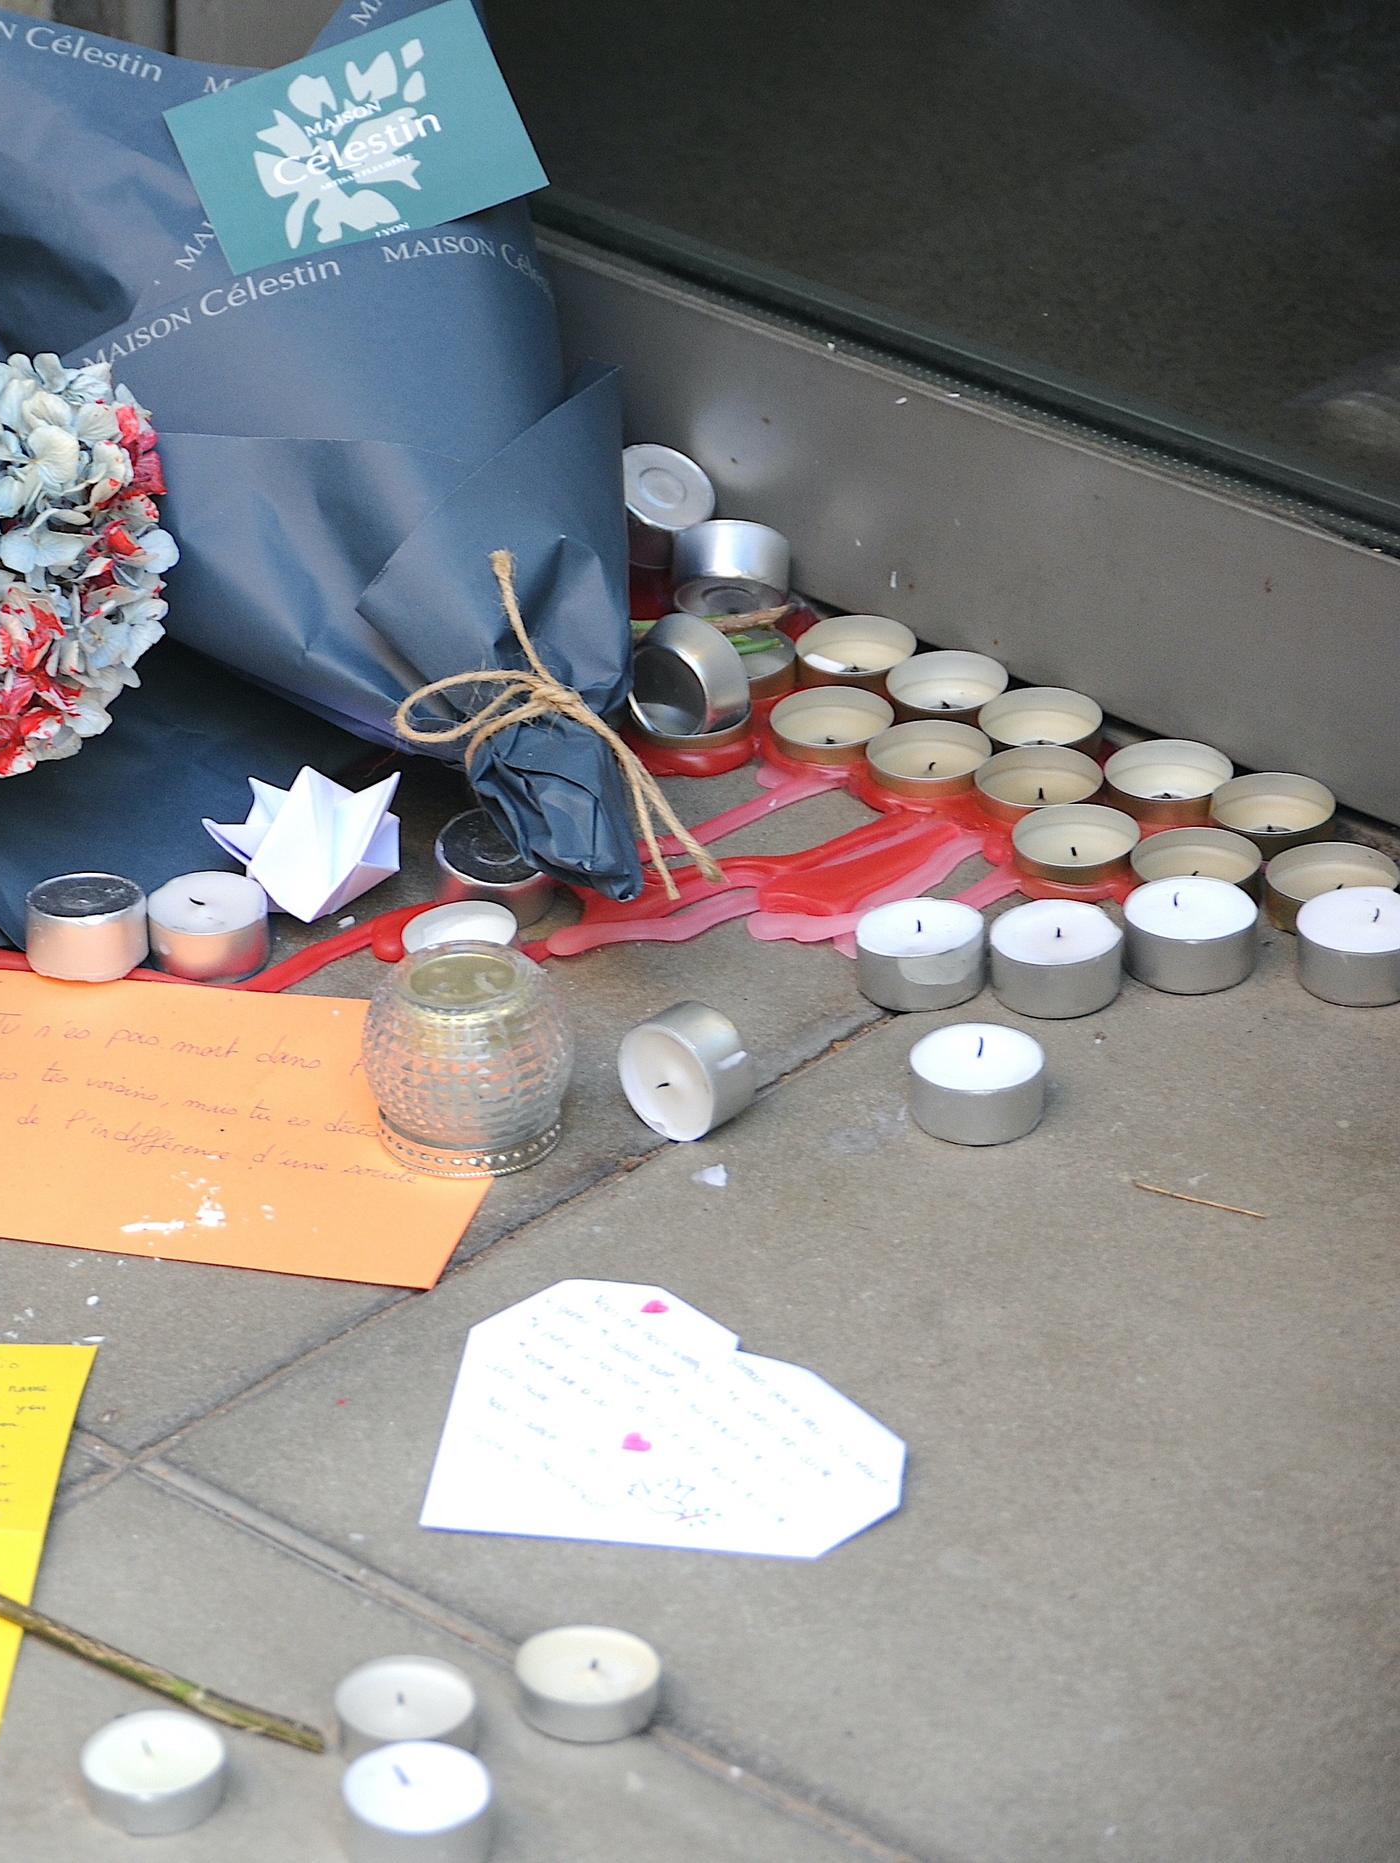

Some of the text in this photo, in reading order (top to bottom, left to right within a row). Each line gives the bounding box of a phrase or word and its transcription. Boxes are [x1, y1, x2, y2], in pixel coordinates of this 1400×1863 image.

[25, 26, 164, 83] Célestin
[304, 100, 382, 138] MAISON
[273, 112, 442, 186] Célestin
[375, 221, 411, 238] LYON
[381, 236, 496, 264] MAISON
[200, 258, 341, 318] Célestin
[105, 1028, 160, 1049] pas
[171, 1036, 240, 1058] mort
[255, 1034, 322, 1069] dans
[16, 1103, 42, 1126] de
[183, 1099, 238, 1116] mais
